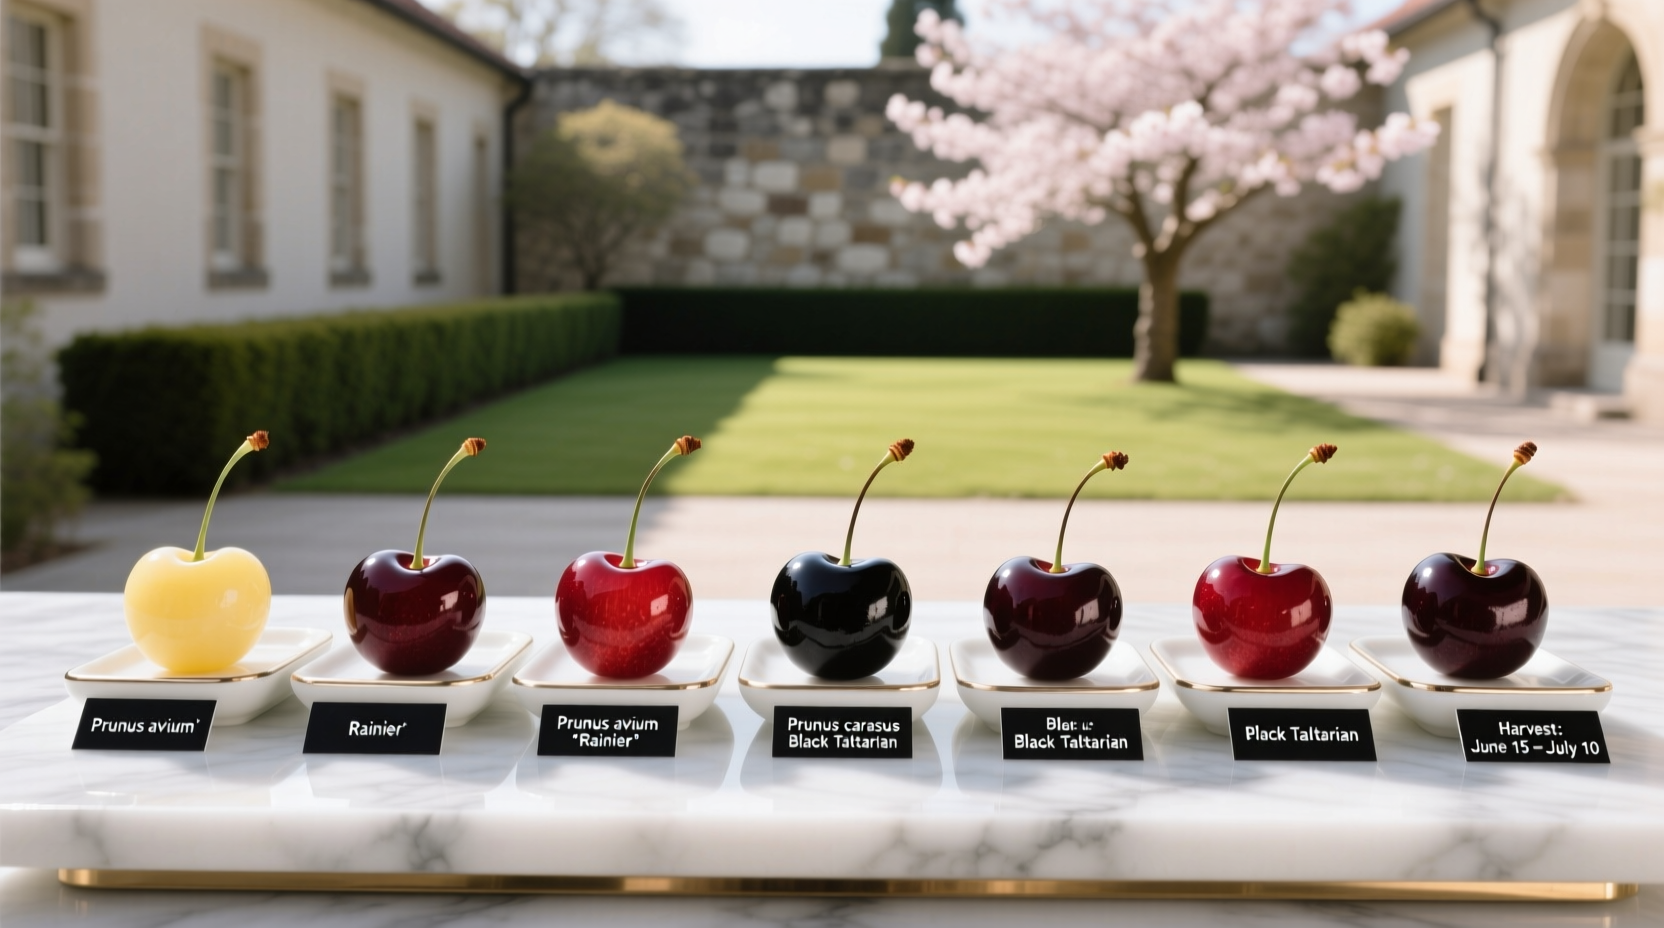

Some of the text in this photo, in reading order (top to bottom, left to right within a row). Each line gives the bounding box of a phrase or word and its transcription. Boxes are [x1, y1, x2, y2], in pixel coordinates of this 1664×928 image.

[90, 717, 145, 733] Prunus
[557, 715, 659, 731] Prunus avium
[787, 716, 901, 733] Prunus carasus
[1498, 720, 1563, 736] Harvest:
[788, 732, 829, 749] Black
[1014, 733, 1128, 750] Black Taltarian
[1289, 726, 1359, 742] Taltarian
[1470, 738, 1508, 754] June
[1511, 739, 1530, 754] 15
[1545, 739, 1577, 759] July
[1581, 740, 1600, 755] 10
